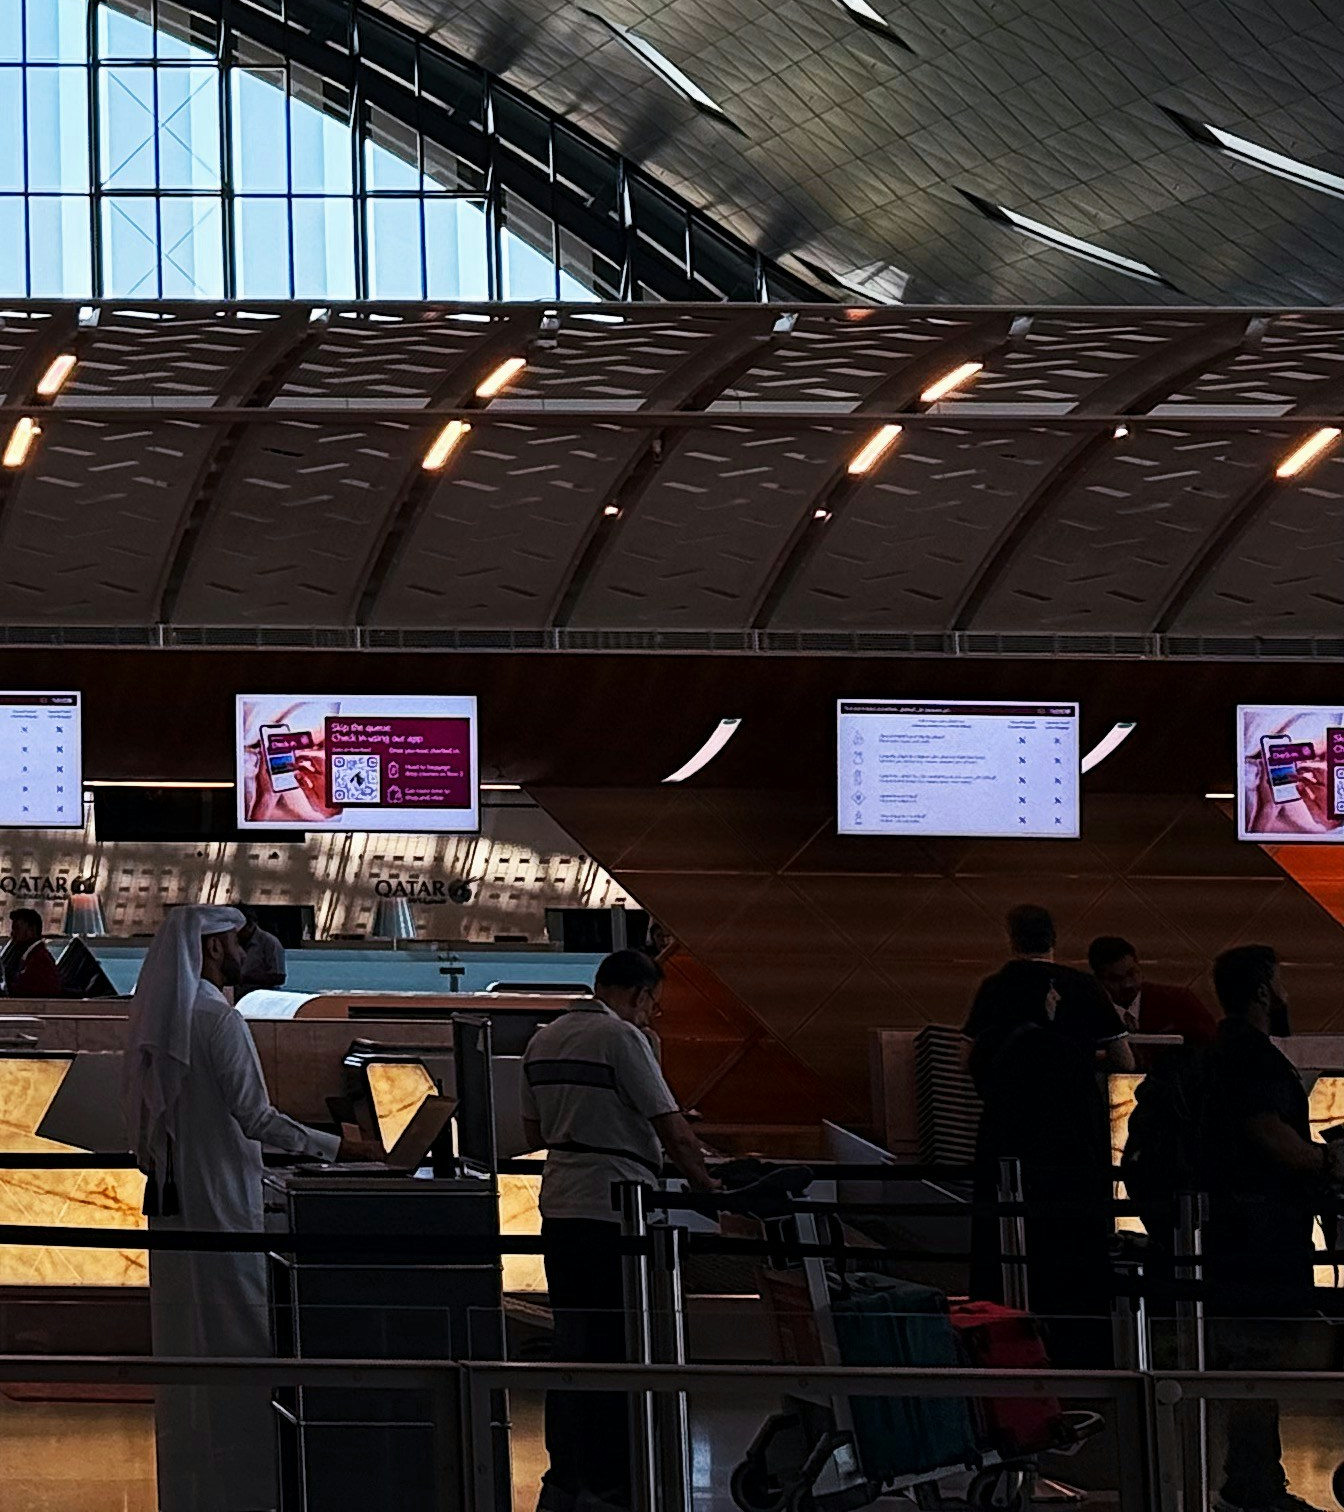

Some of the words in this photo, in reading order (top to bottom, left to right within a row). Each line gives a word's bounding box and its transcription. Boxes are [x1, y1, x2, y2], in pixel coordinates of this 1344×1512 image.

[331, 723, 349, 733] Skip
[351, 723, 364, 732] the
[331, 733, 356, 742] Check
[407, 736, 424, 744] app
[0, 876, 68, 896] QATAR
[374, 879, 445, 897] QATAR
